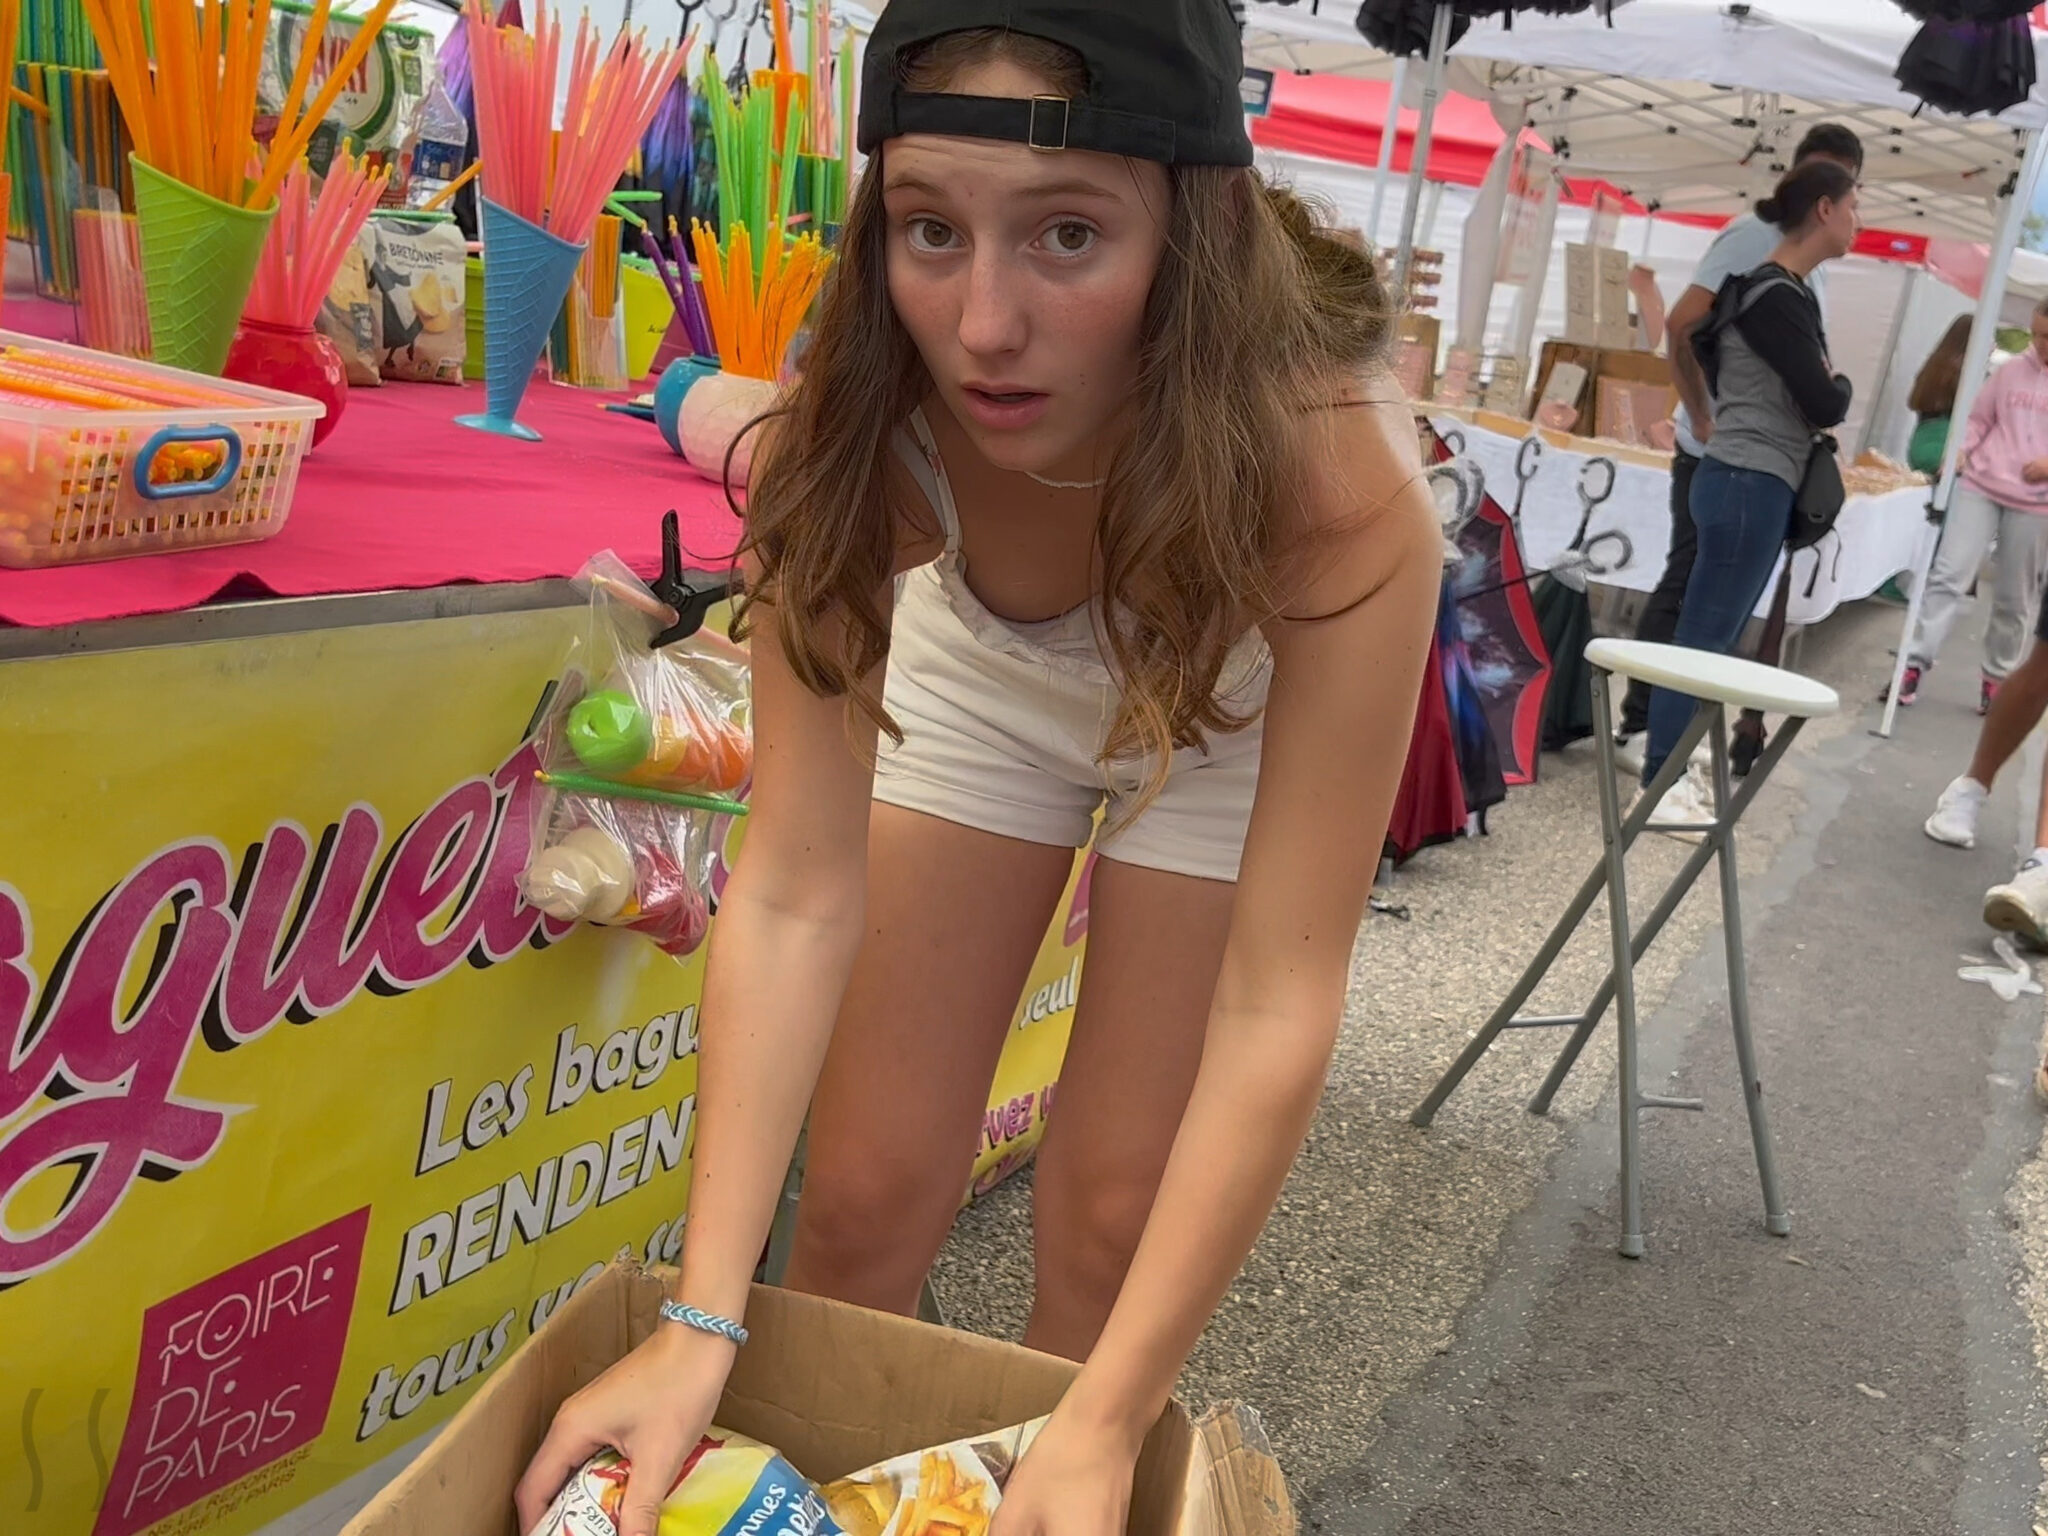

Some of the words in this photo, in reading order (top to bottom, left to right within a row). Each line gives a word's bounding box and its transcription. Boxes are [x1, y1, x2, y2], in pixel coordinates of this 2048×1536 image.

[415, 1064, 534, 1176] Les
[545, 1004, 700, 1115] bagu
[388, 1092, 696, 1316] RENDEN
[159, 1245, 339, 1386] FOIRE
[356, 1307, 516, 1442] tous
[123, 1384, 301, 1519] PARIS
[145, 1356, 242, 1454] DE
